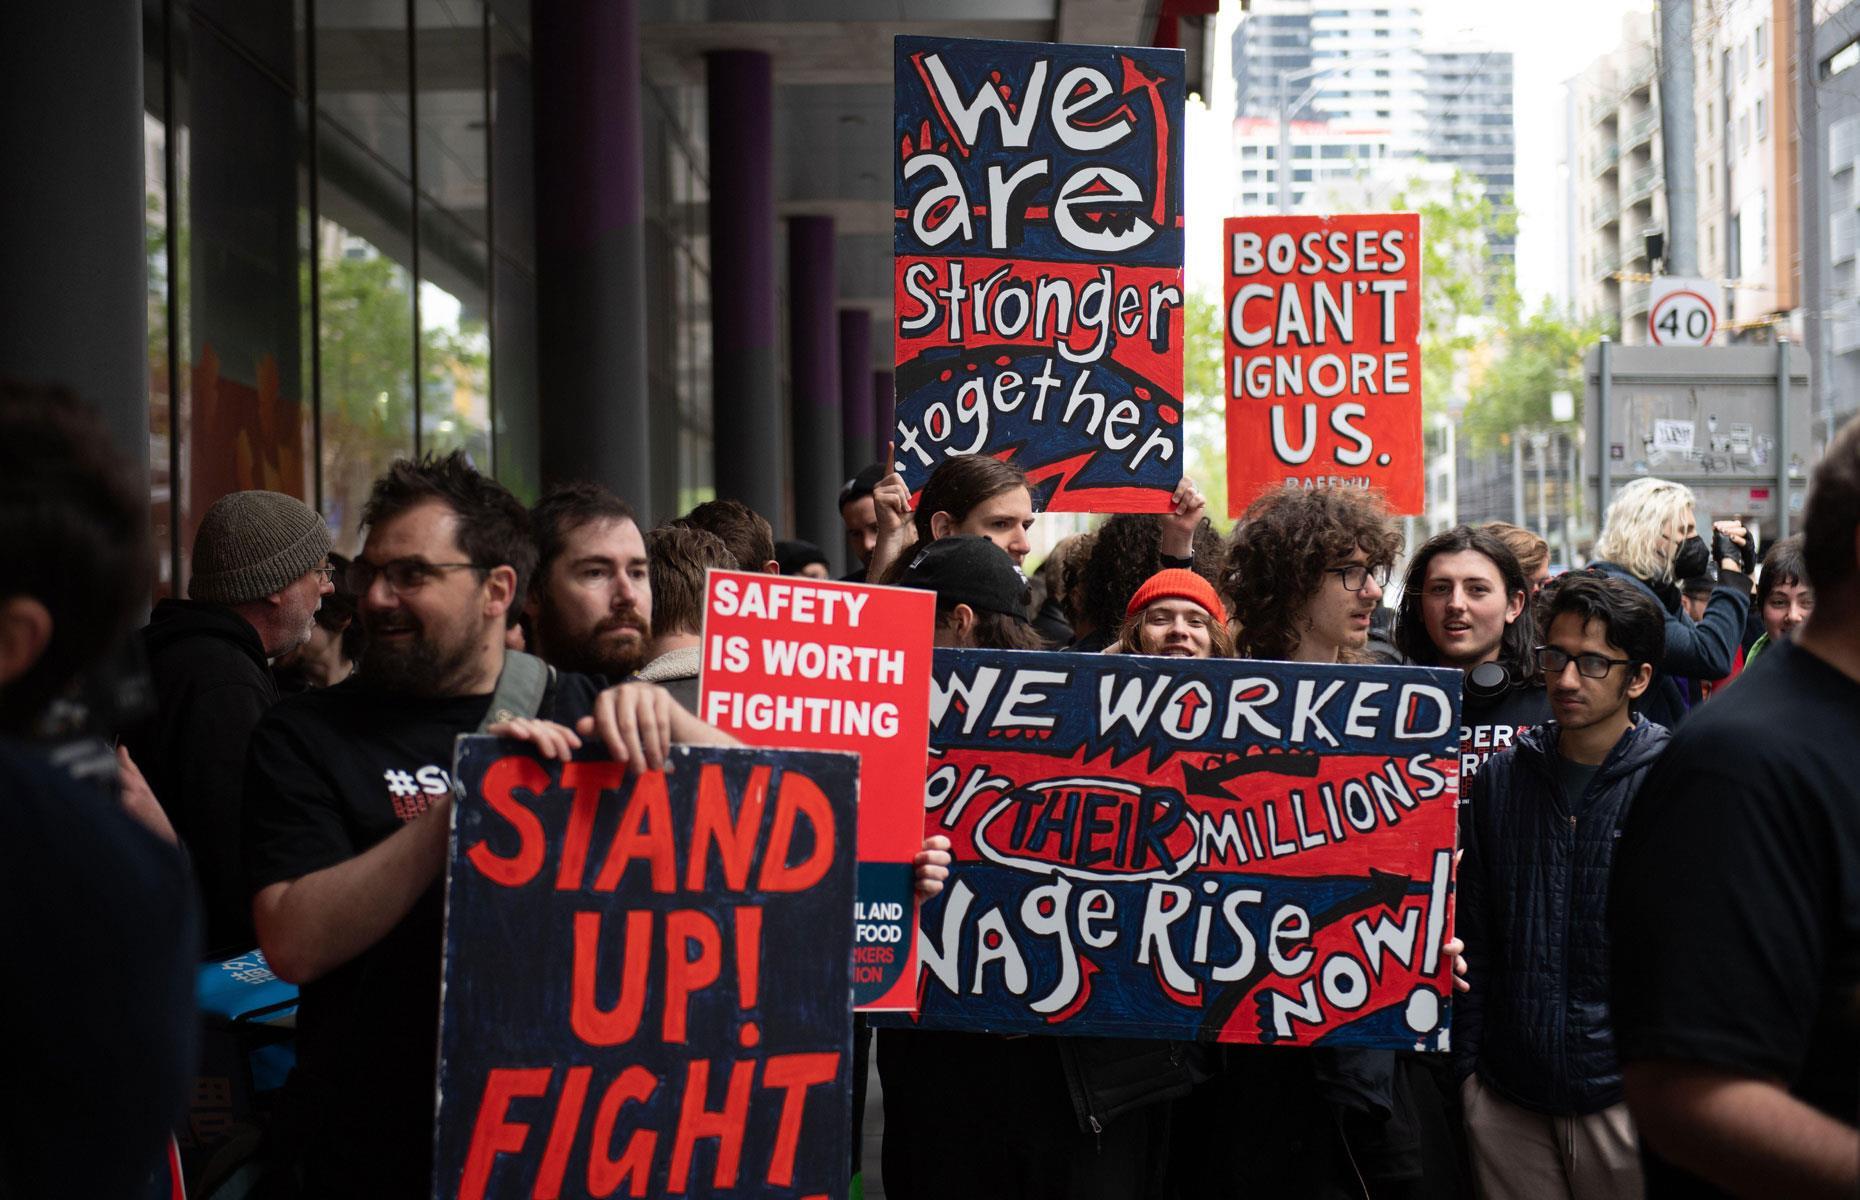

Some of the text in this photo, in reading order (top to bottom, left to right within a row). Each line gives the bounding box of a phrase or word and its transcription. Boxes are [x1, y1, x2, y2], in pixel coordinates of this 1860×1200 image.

[904, 153, 1155, 252] are
[1232, 230, 1406, 275] BOSSES
[902, 262, 1180, 364] Stronger
[1231, 279, 1408, 347] CAN'T
[1657, 307, 1709, 340] 40
[1233, 352, 1411, 398] IGNORE
[898, 358, 1174, 471] together
[1271, 402, 1392, 466] US.
[712, 578, 870, 628] SAFETY
[710, 634, 905, 685] IS WORTH
[707, 690, 899, 738] FIGHTING
[929, 666, 1452, 747] WE WORKED
[466, 755, 836, 893] STAND
[925, 753, 1446, 875] or THEIR MILLIONS
[856, 923, 902, 943] FOOD
[868, 901, 903, 921] AND
[569, 905, 763, 1049] UP!
[458, 1052, 841, 1200] FIGHT
